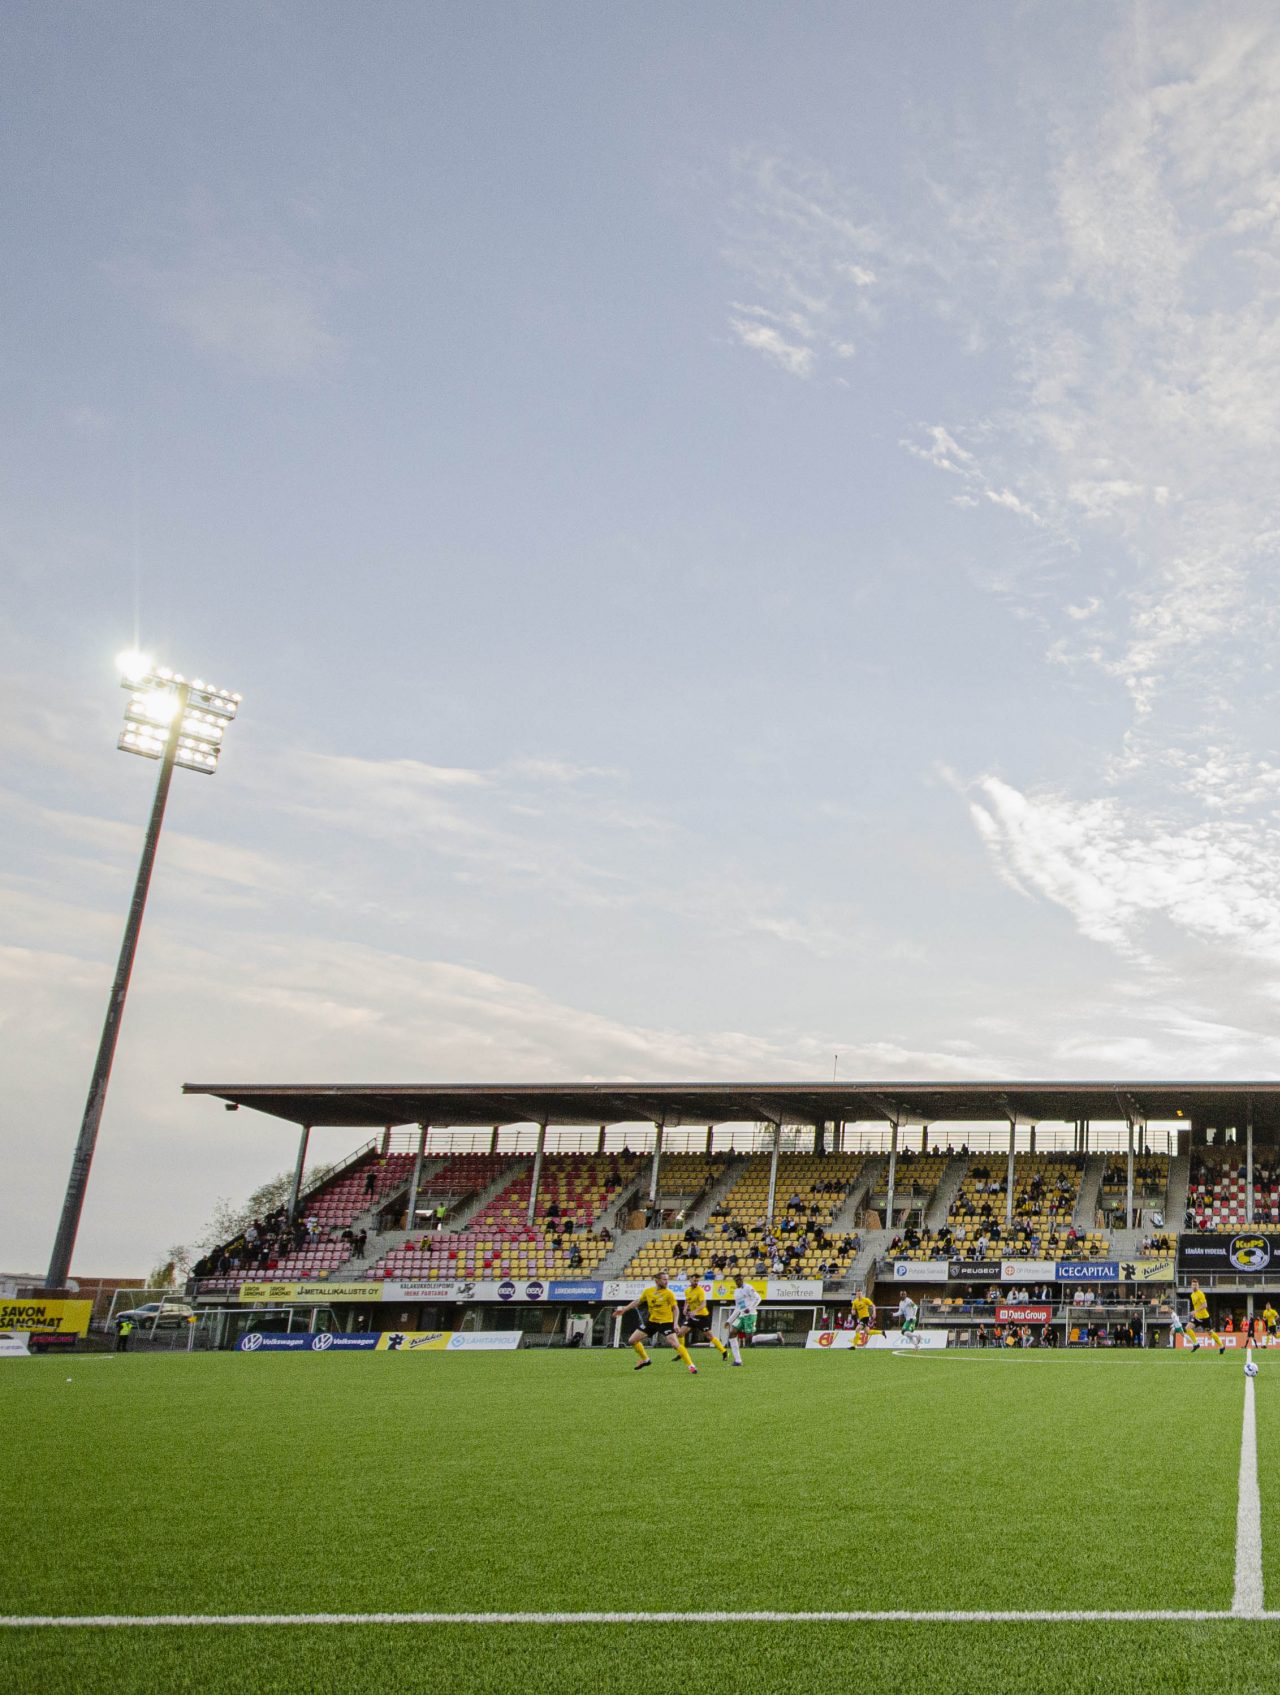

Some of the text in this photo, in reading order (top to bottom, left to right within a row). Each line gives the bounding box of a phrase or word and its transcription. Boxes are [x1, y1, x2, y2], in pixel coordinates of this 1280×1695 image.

[1235, 1240, 1264, 1249] KuPS
[1059, 1266, 1115, 1276] ICECAPITAL
[776, 1288, 814, 1297] Talentree
[1, 1306, 46, 1316] SAVON
[1026, 1310, 1047, 1320] Group
[0, 1318, 63, 1328] SANOMAT
